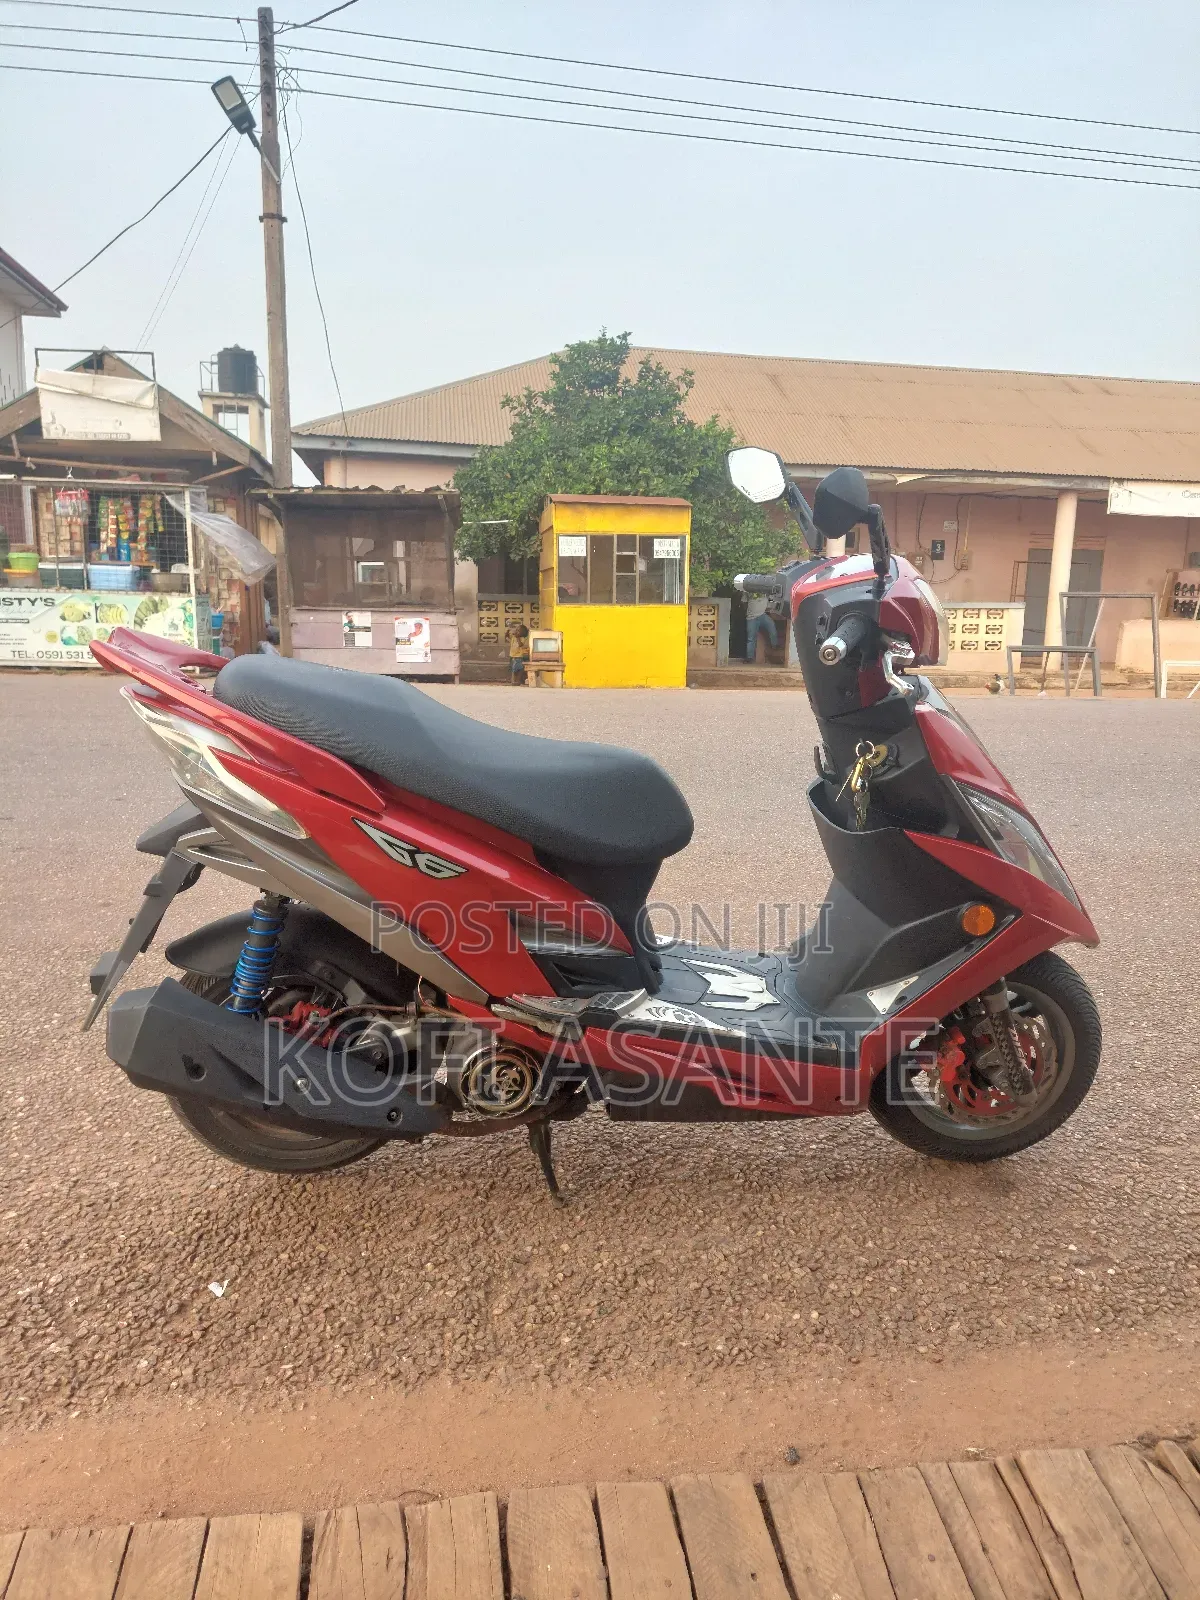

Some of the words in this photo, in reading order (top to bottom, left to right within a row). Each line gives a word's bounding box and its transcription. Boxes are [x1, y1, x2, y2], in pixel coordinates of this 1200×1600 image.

[10, 650, 35, 659] TEL:
[36, 650, 64, 659] 0591
[66, 650, 86, 660] 531
